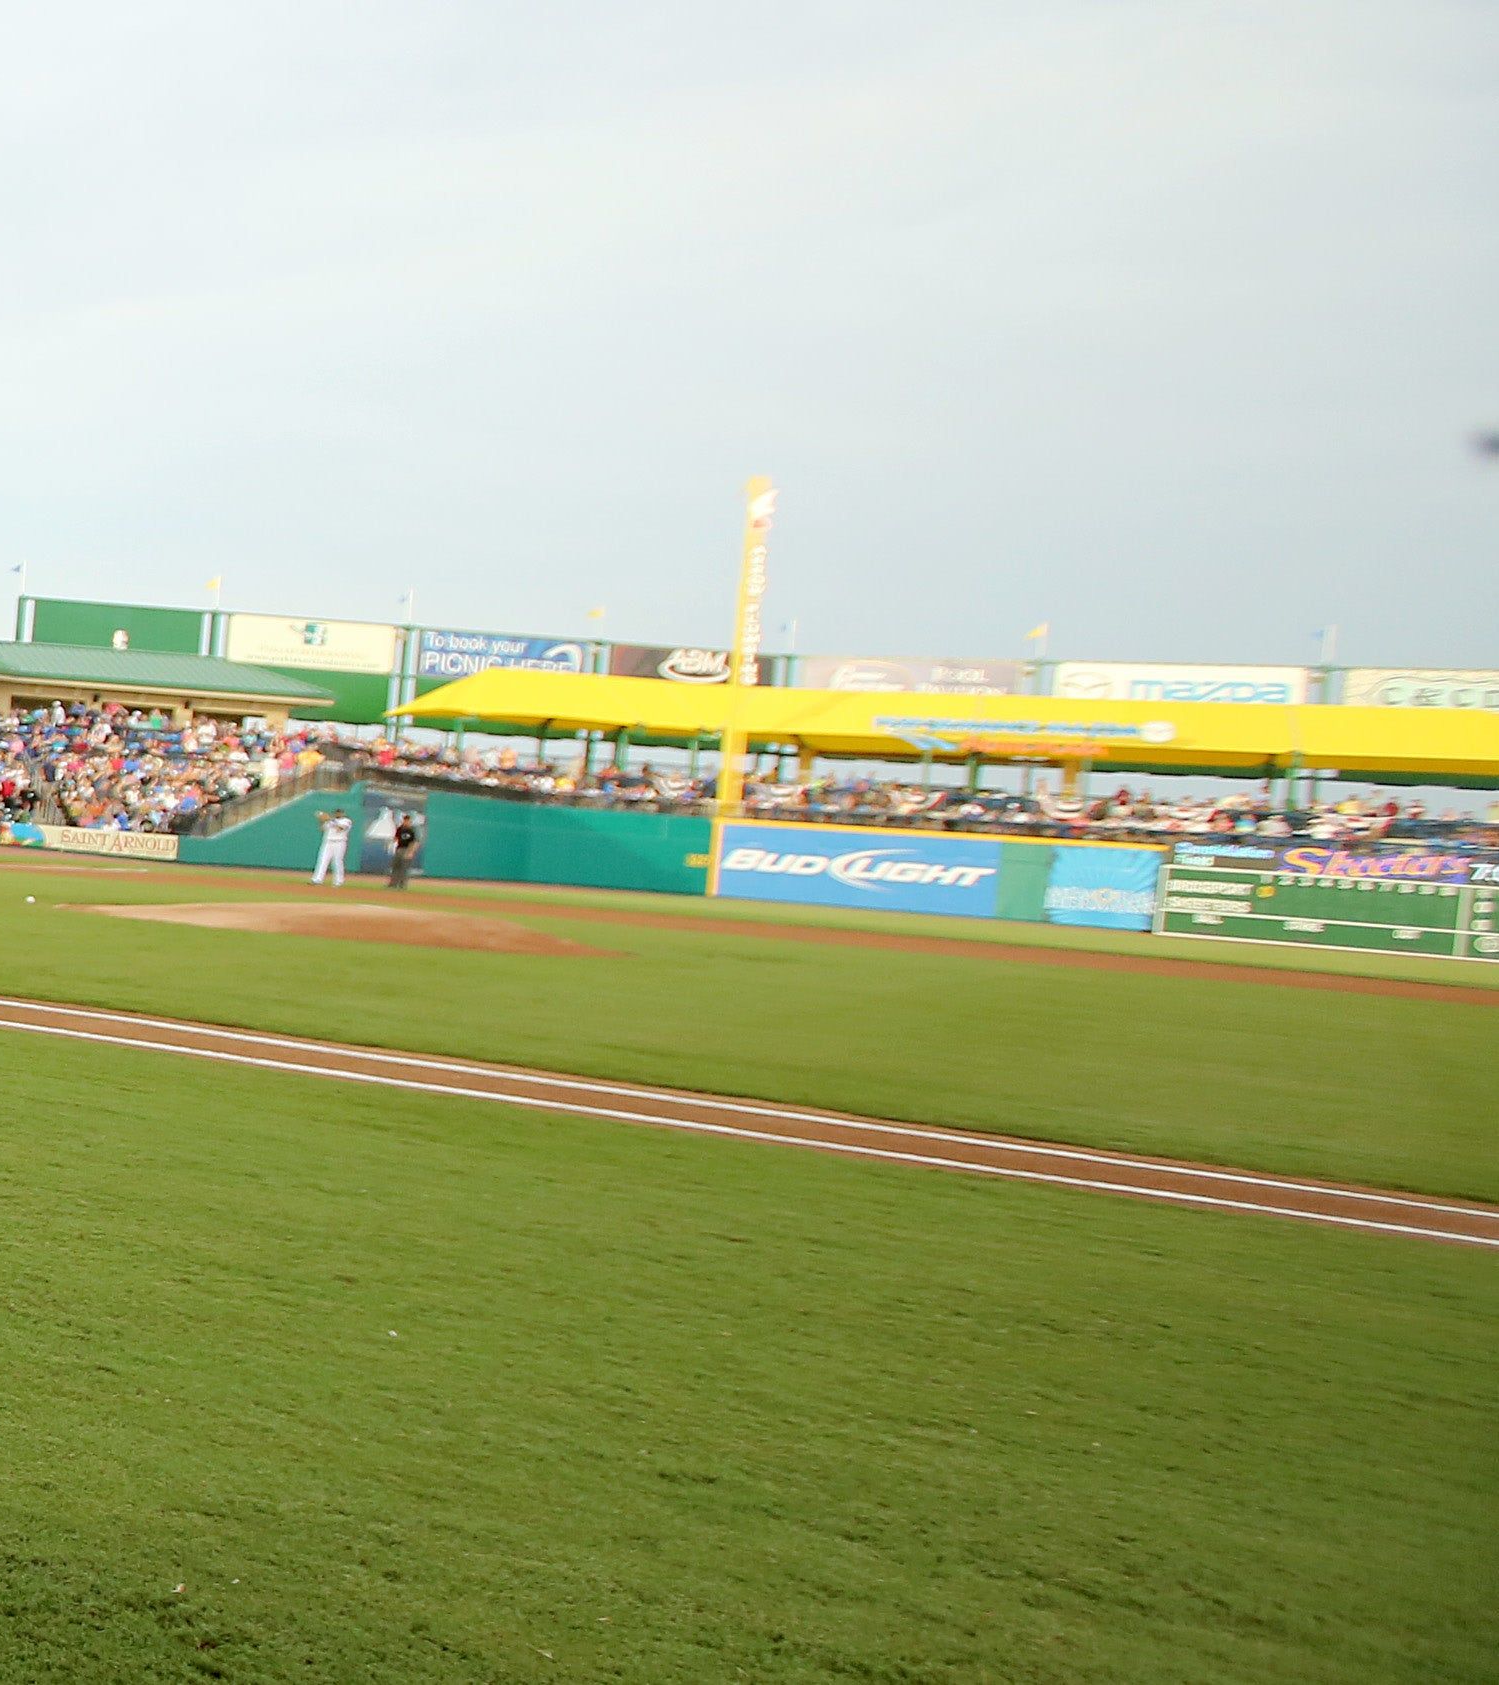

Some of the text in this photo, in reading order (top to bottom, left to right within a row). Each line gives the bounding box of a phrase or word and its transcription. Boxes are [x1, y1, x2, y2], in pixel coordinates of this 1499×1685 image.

[427, 631, 529, 653] To book your
[61, 829, 177, 852] SAINT ARNOLD
[720, 848, 831, 876] BUD
[847, 857, 997, 887] LIGHT
